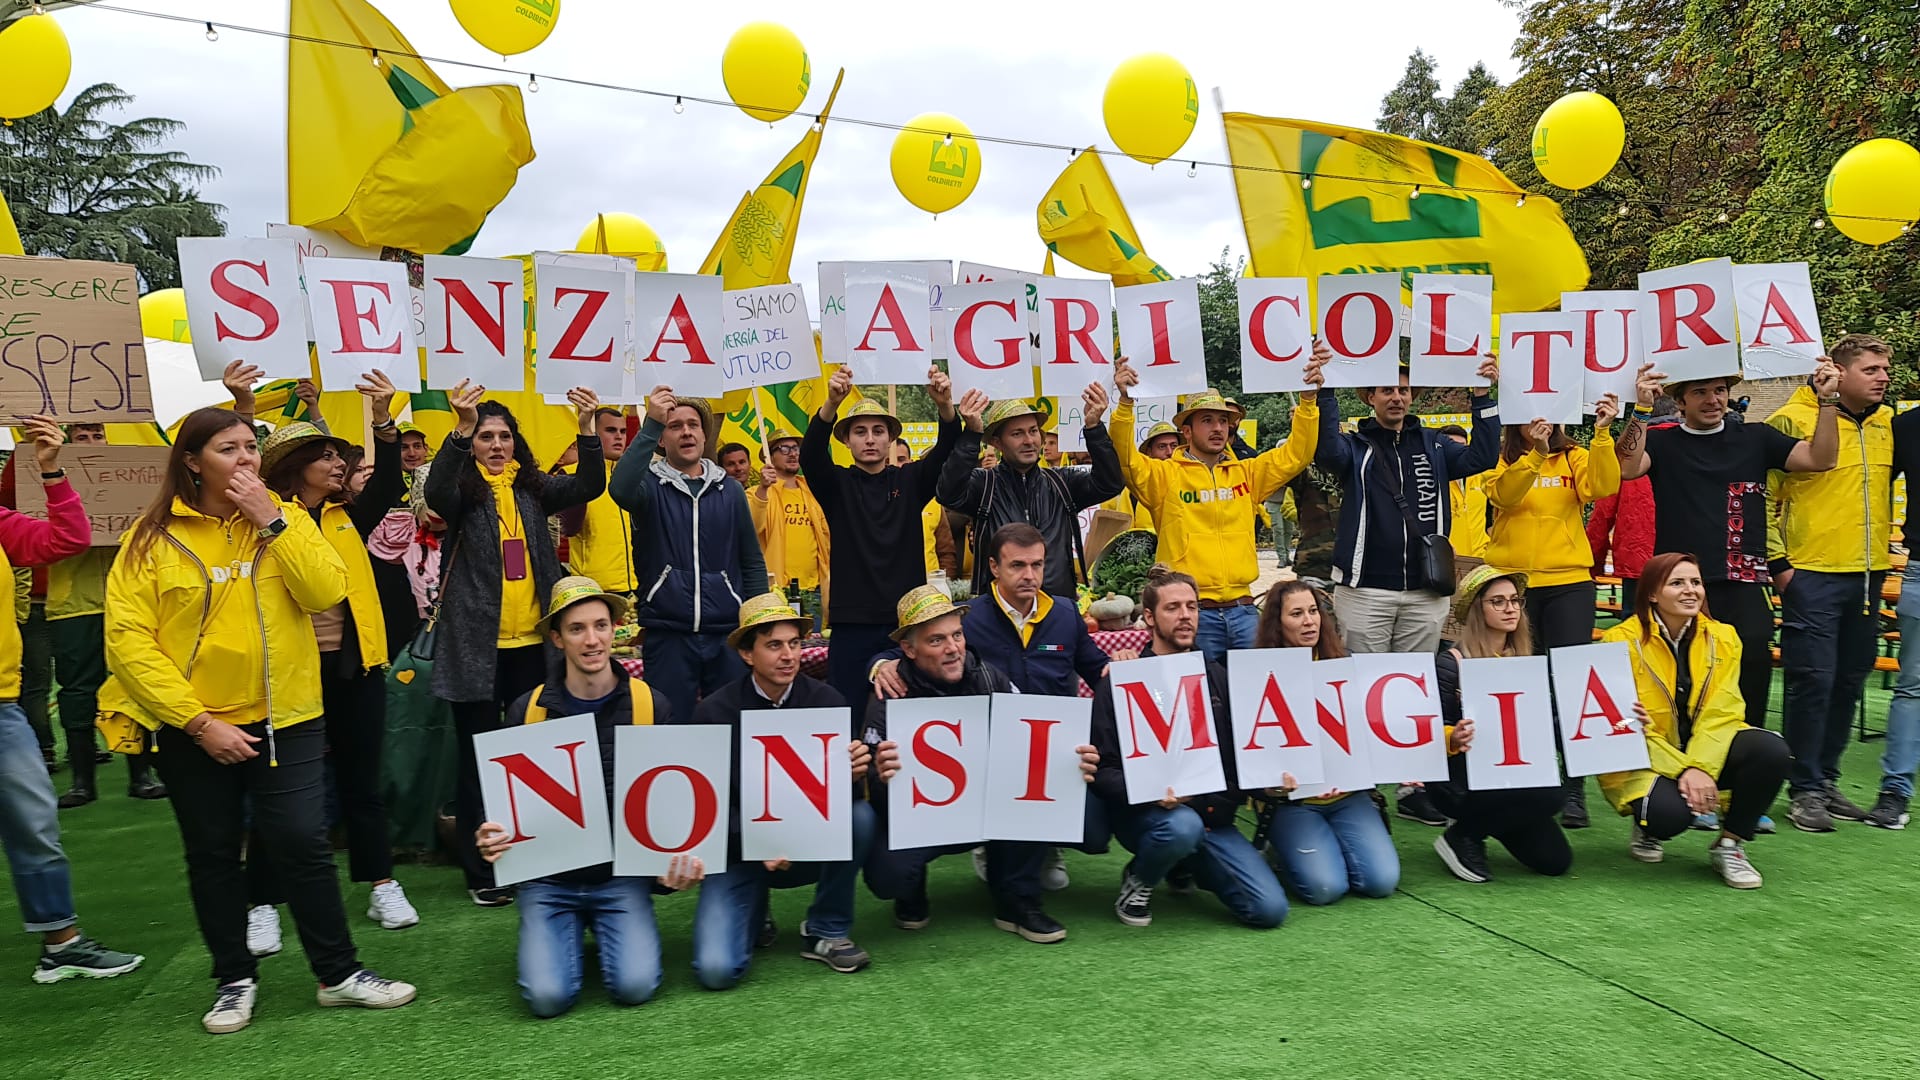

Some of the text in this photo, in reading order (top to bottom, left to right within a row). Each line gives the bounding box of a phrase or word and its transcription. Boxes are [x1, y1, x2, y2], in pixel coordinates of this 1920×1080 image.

[927, 174, 963, 188] COLDIRETTI
[211, 260, 716, 365] SENZA
[852, 280, 1817, 394] AGRICOLTURA
[762, 327, 789, 343] DEL
[488, 666, 1637, 854] NON SI MANGIA
